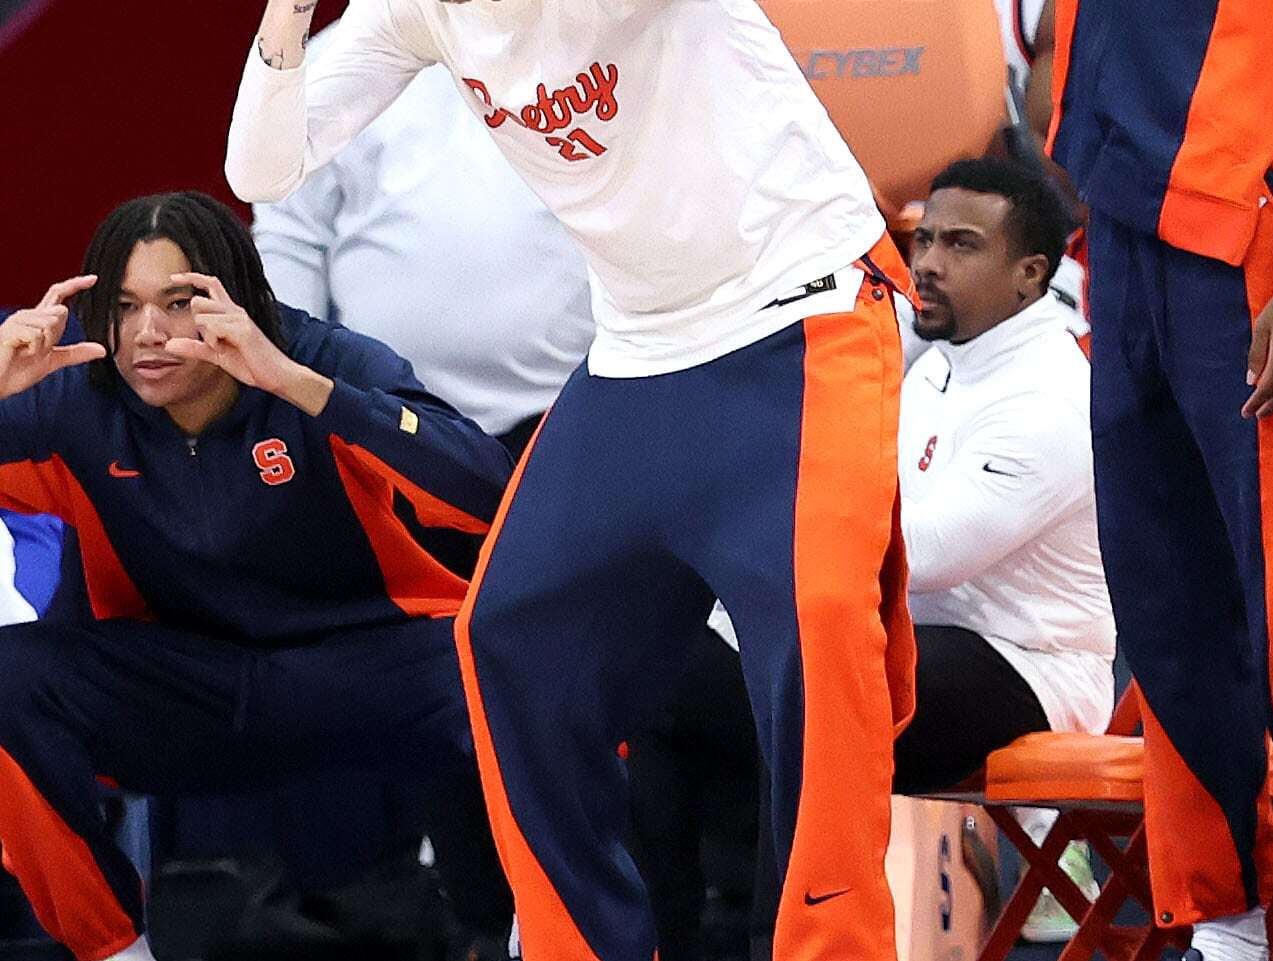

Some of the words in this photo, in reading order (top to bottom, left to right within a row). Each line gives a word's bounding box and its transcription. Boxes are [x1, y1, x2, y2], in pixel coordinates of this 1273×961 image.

[808, 47, 926, 80] CYBEX
[545, 127, 608, 162] 21
[251, 437, 295, 486] S
[918, 435, 937, 472] S
